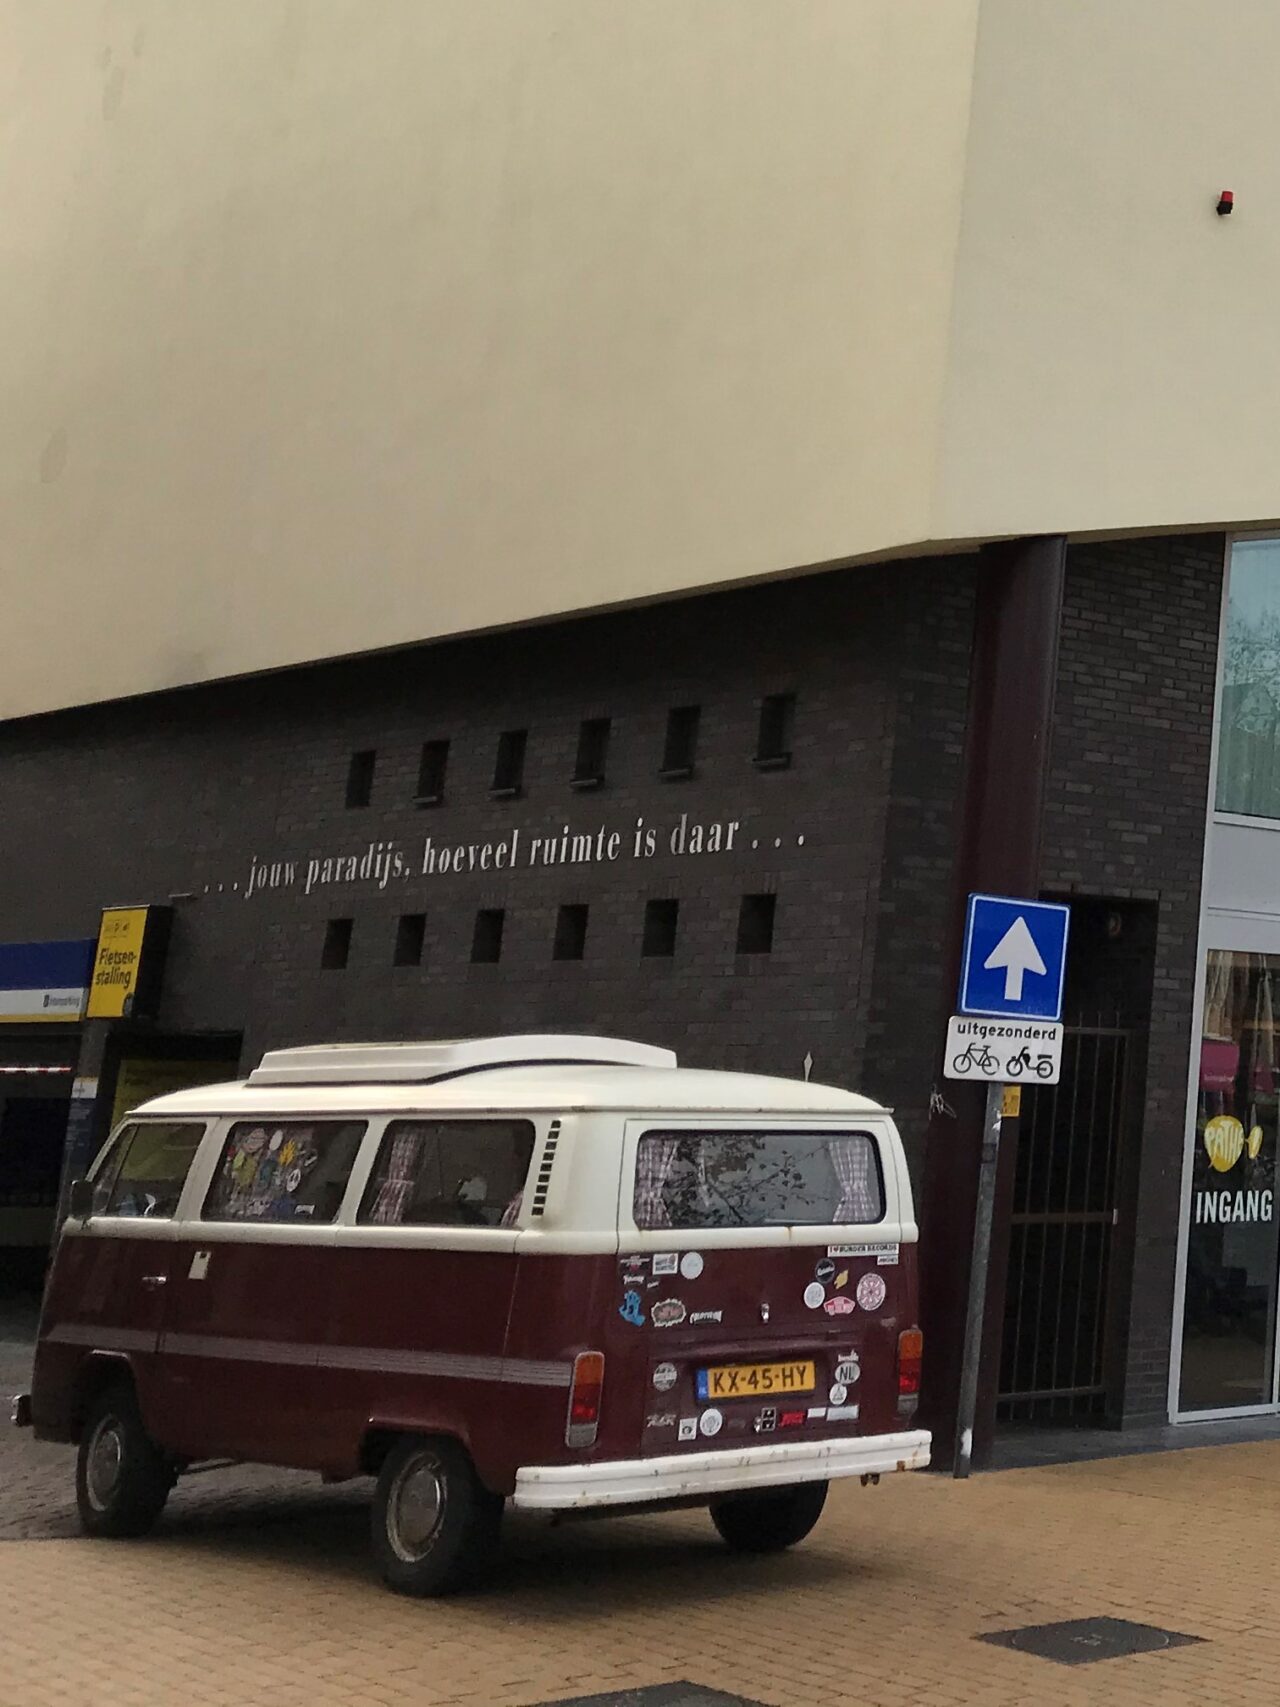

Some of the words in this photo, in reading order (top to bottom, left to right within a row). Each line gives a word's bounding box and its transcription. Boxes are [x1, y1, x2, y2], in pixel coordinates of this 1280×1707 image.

[243, 855, 298, 900] jouw
[304, 841, 411, 895] paradijs,
[422, 828, 519, 875] hoeveel
[529, 824, 622, 866] ruimte
[632, 817, 657, 858] is
[670, 813, 740, 855] daar
[95, 967, 132, 989] stalling
[956, 1022, 1058, 1041] uitgezonderd
[1195, 1189, 1273, 1224] INGANG
[713, 1365, 807, 1394] KX-45-HY
[839, 1365, 854, 1381] NL
